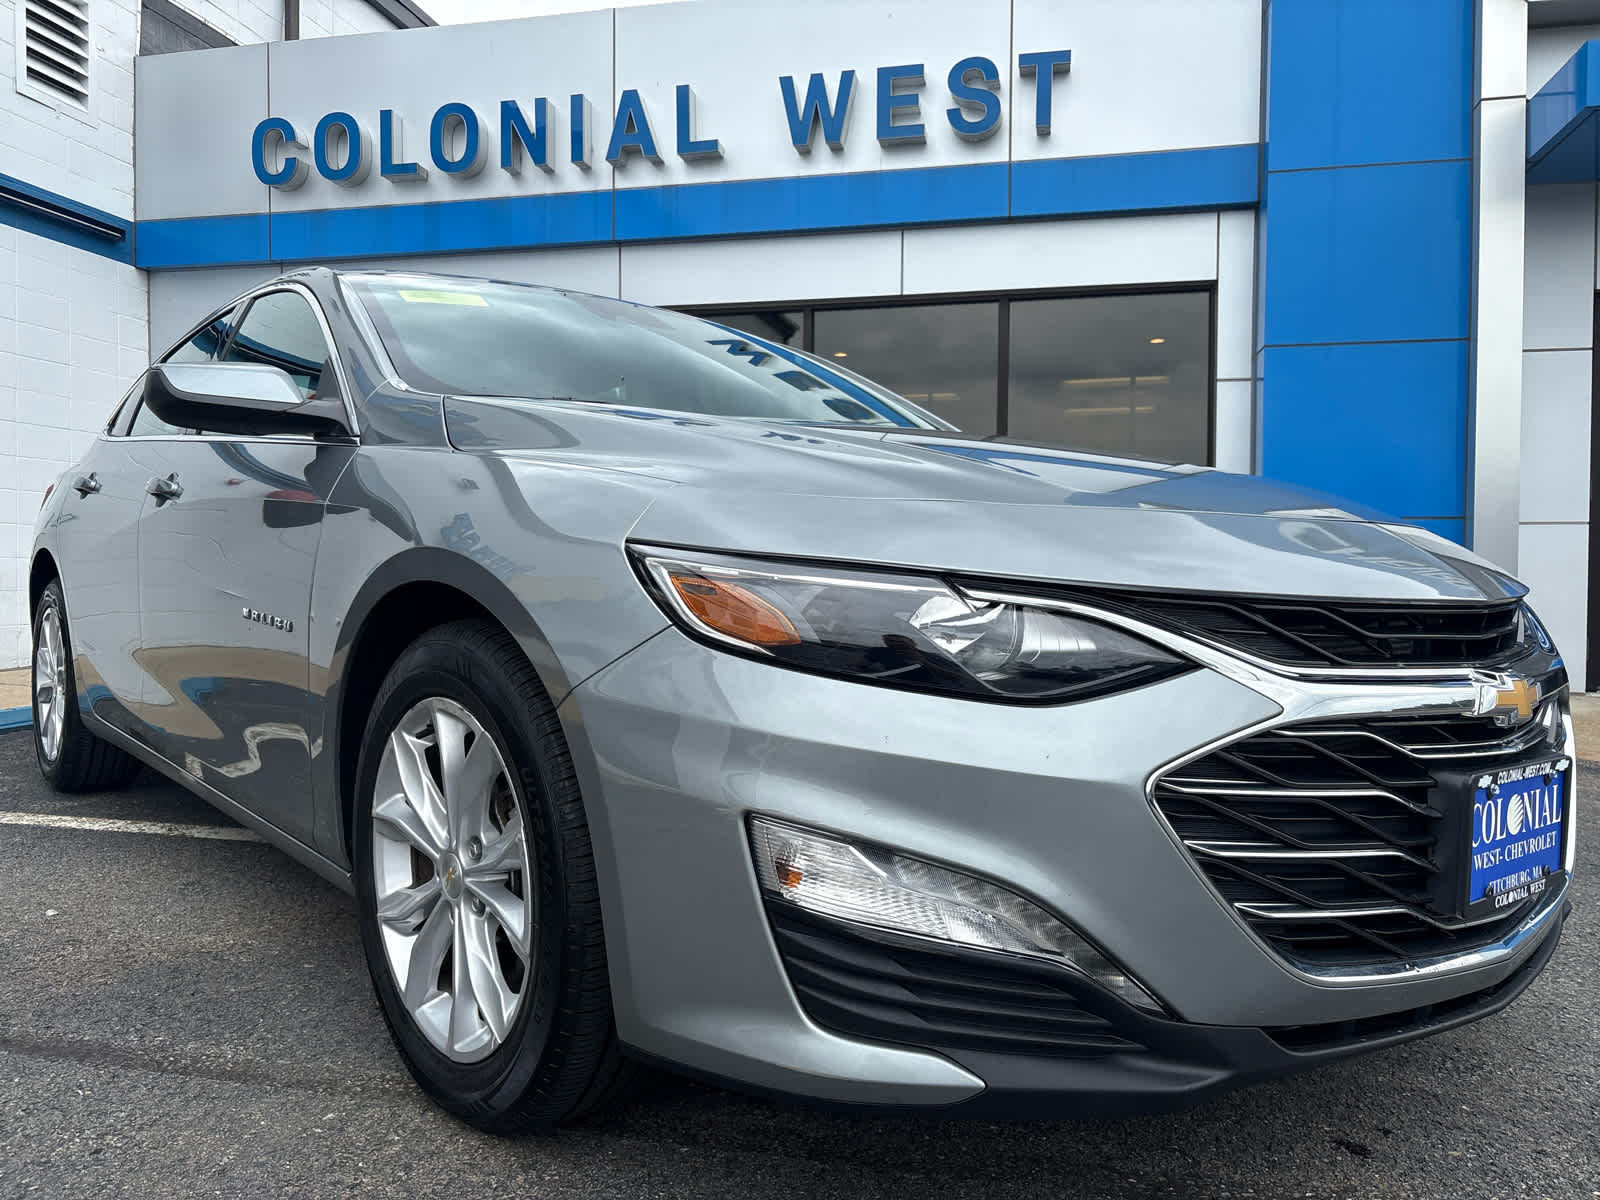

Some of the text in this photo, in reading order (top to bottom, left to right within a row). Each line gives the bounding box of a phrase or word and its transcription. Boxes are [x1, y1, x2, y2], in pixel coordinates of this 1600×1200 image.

[251, 49, 1072, 190] COLONIAL WEST
[1472, 784, 1561, 848] COLONIAL
[1495, 878, 1546, 908] COLONIAL WEST
